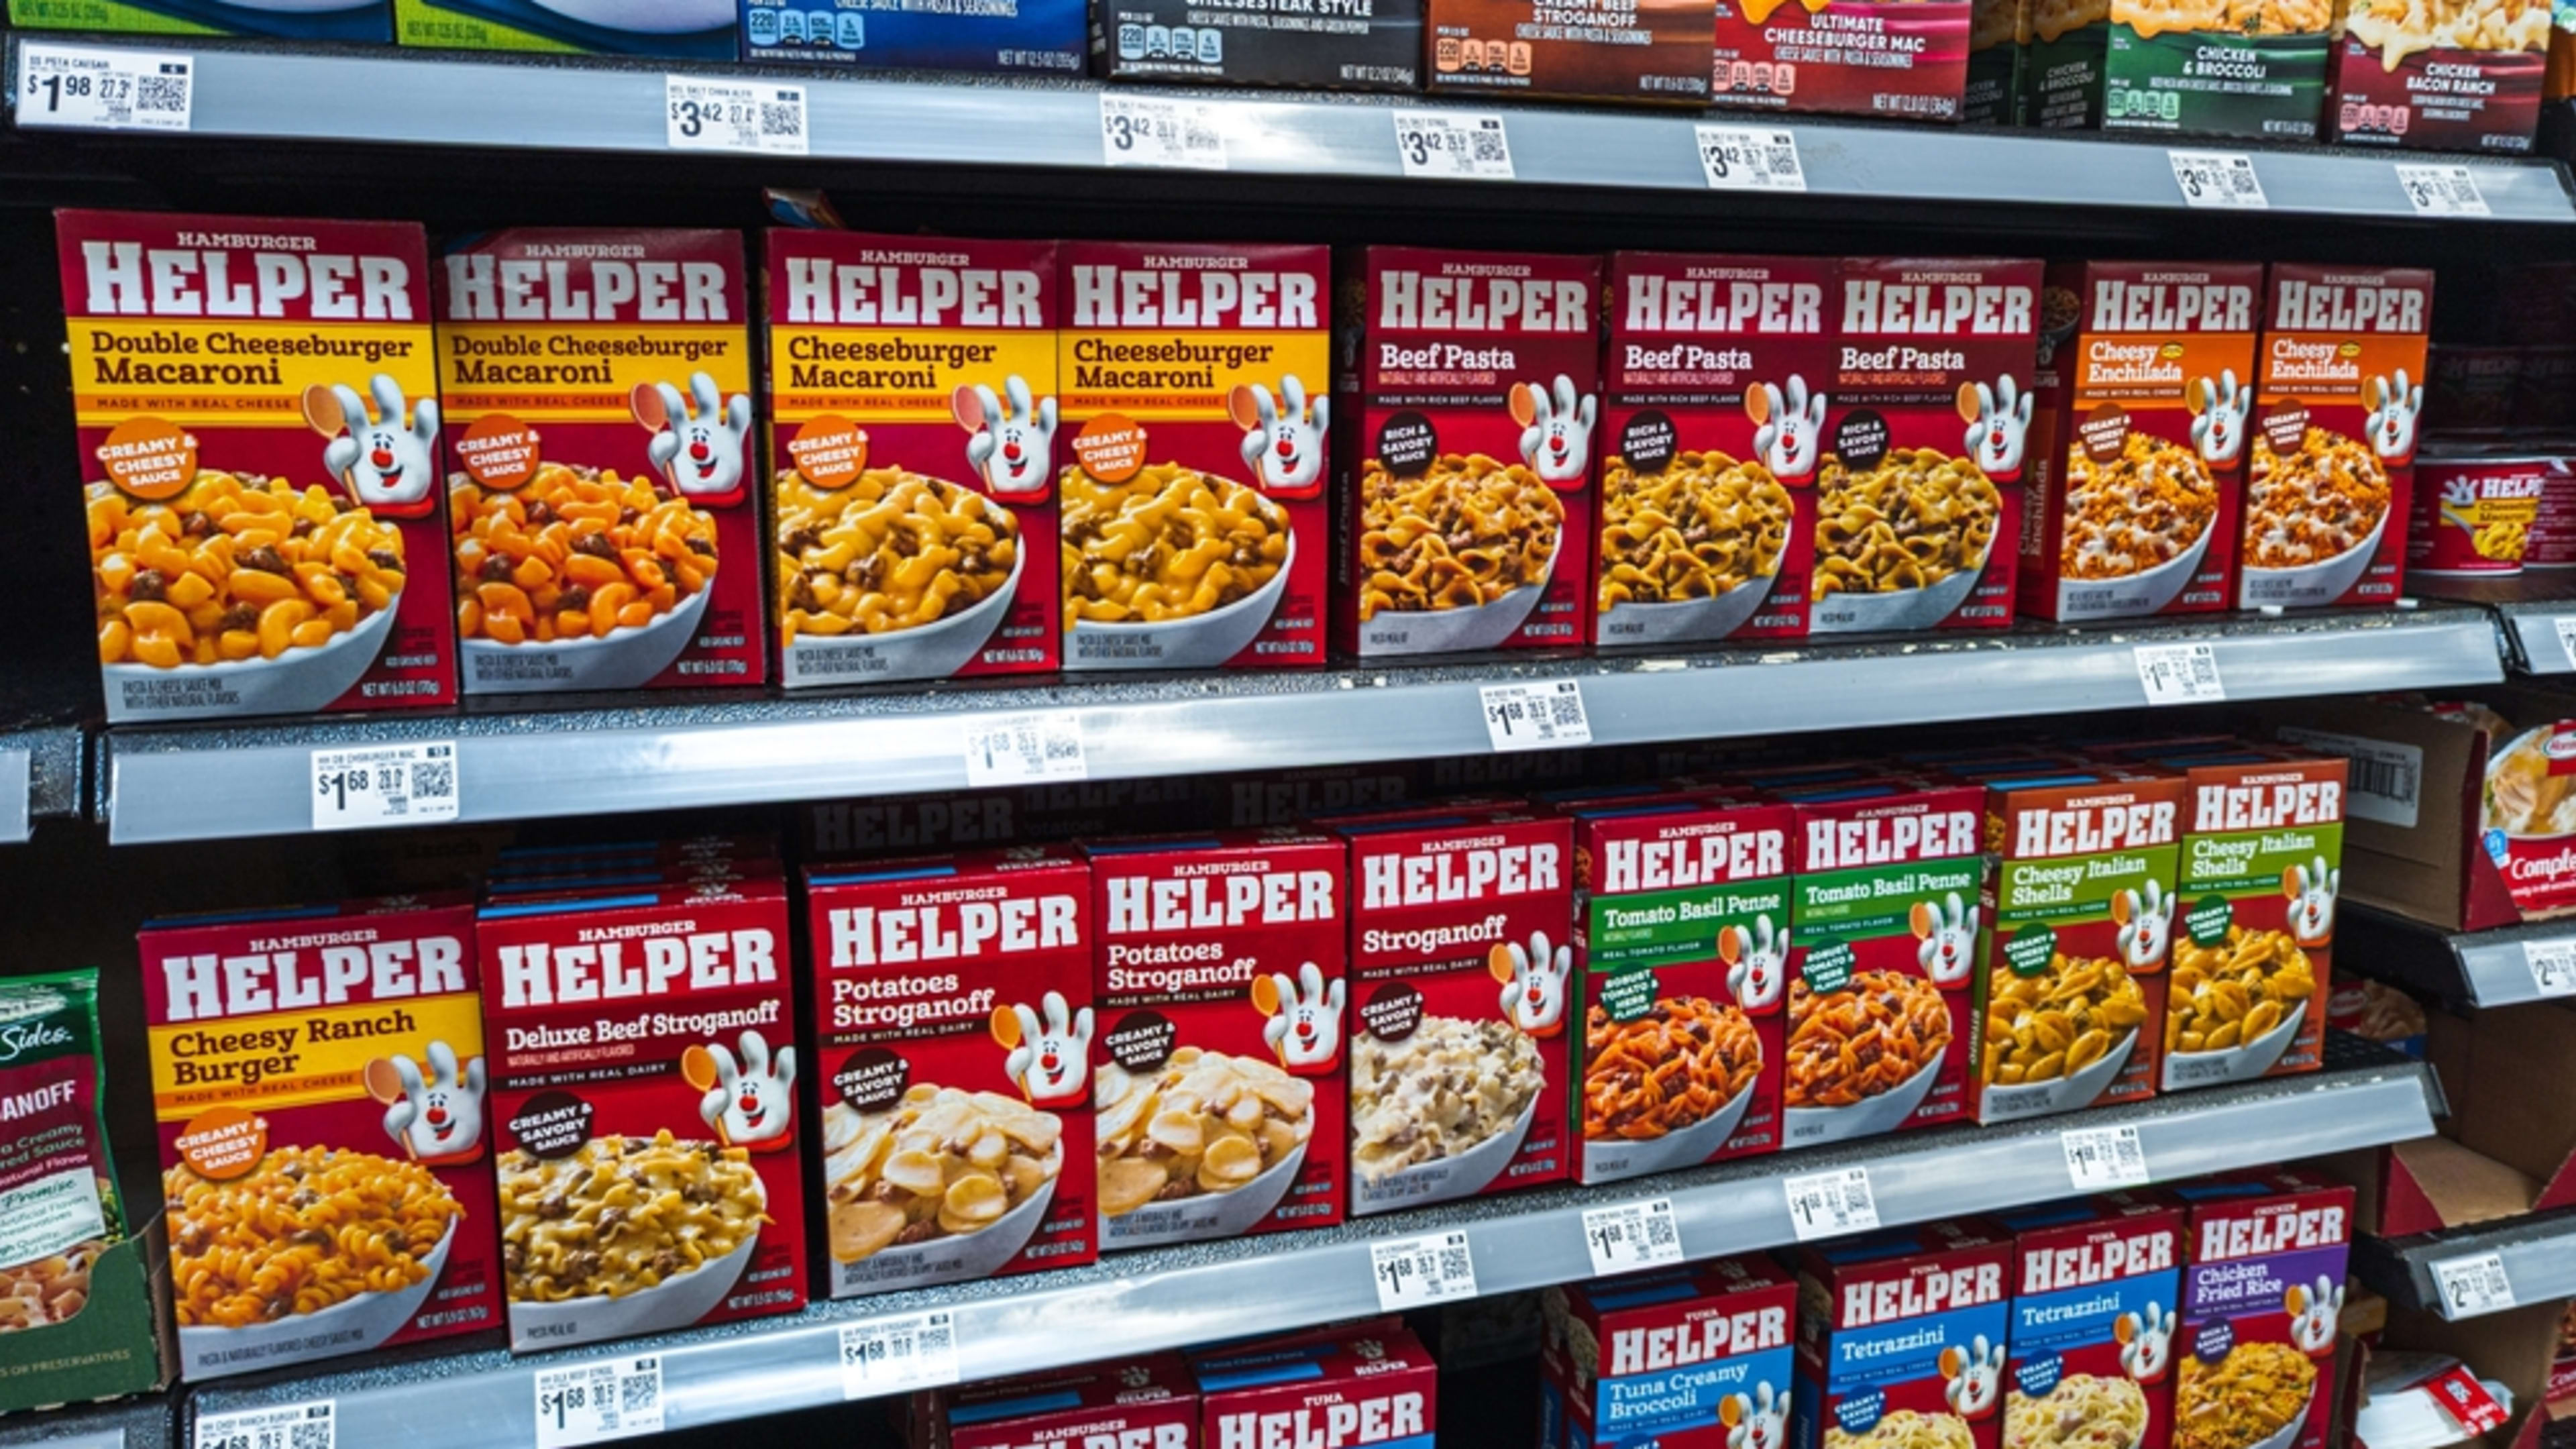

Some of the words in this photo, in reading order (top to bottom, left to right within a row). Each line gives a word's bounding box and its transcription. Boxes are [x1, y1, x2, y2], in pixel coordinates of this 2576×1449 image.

[1318, 1, 1372, 16] STYLE
[1533, 10, 1637, 27] STROGANOFF
[1811, 14, 1884, 32] ULTIMATE
[1764, 28, 1886, 50] CHEESEBURGER
[1890, 35, 1926, 52] MAC
[2196, 46, 2257, 63] CHICKEN
[2183, 62, 2194, 75] &
[2196, 61, 2267, 78] BROCCOLI
[2426, 62, 2481, 78] CHICKEN
[2406, 75, 2452, 93] BACON
[2454, 78, 2496, 96] RANCH
[176, 231, 317, 252] HAMBURGER
[524, 244, 645, 259] HAMBURGER
[860, 250, 970, 266] HAMBURGER
[1143, 256, 1248, 270] HAMBURGER
[1442, 262, 1532, 277] HAMBURGER
[82, 240, 413, 320] HELPER
[1685, 268, 1770, 280] HAMBURGER
[1901, 272, 1983, 284] HAMBURGER
[445, 254, 729, 321] HELPER
[785, 256, 1043, 327] HELPER
[1072, 265, 1318, 328] HELPER
[1379, 270, 1589, 333] HELPER
[1625, 275, 1822, 333] HELPER
[1841, 280, 2033, 334] HELPER
[2092, 280, 2252, 331] HELPER
[2275, 280, 2424, 332] HELPER
[91, 330, 199, 354] Double
[205, 332, 412, 363] Cheeseburger
[451, 335, 543, 357] Double
[547, 335, 728, 361] Cheeseburger
[788, 335, 997, 369] Cheeseburger
[1074, 338, 1273, 370] Cheeseburger
[1379, 342, 1442, 370] Beef
[1444, 344, 1516, 370] Pasta
[1624, 343, 1684, 370] Beef
[1684, 345, 1753, 370] Pasta
[1839, 345, 1898, 370] Beef
[1900, 347, 1966, 370] Pasta
[2088, 341, 2159, 363] Cheesy
[2272, 338, 2338, 362] Cheesy
[94, 356, 283, 385] Macaroni
[454, 358, 613, 384] Macaroni
[790, 364, 937, 390] Macaroni
[1074, 365, 1215, 389] Macaroni
[2088, 362, 2183, 383] Enchilada
[2271, 360, 2359, 380] Enchilada
[97, 398, 140, 409] MADE
[146, 398, 186, 409] WITH
[191, 398, 229, 409] REAL
[236, 398, 291, 410] CHEESE
[95, 437, 176, 460] CREAMY
[182, 434, 199, 448] &
[455, 432, 525, 454] CREAMY
[113, 451, 189, 474] CHEESY
[127, 469, 181, 487] SAUCE
[2195, 780, 2341, 831] HELPER
[1659, 822, 1737, 839] HAMBURGER
[1806, 810, 1976, 871] HELPER
[2015, 801, 2176, 859] HELPER
[1421, 835, 1506, 853] HAMBURGER
[2192, 838, 2259, 859] Cheesy
[2261, 833, 2315, 854] Italian
[1173, 860, 1271, 877] HAMBURGER
[1605, 829, 1784, 893] HELPER
[2012, 864, 2084, 885] Cheesy
[2087, 856, 2146, 879] Italian
[2192, 857, 2248, 877] Shells
[1362, 843, 1560, 910] HELPER
[1805, 882, 1871, 905] Tomato
[1873, 875, 1916, 897] Basil
[1918, 872, 1971, 892] Penne
[900, 886, 1008, 906] HAMBURGER
[1106, 869, 1335, 934] HELPER
[2012, 883, 2073, 906] Shells
[1604, 906, 1676, 929] Tomato
[1678, 897, 1725, 921] Basil
[1726, 894, 1780, 915] Penne
[250, 928, 379, 953] HAMBURGER
[578, 920, 697, 943] HAMBURGER
[828, 894, 1079, 968] HELPER
[1362, 914, 1507, 954] Stroganoff
[498, 927, 777, 1008] HELPER
[1107, 942, 1224, 967] Potatoes
[162, 935, 466, 1022] HELPER
[1107, 957, 1257, 992] Stroganoff
[831, 974, 959, 1002] Potatoes
[833, 987, 996, 1028] Stroganoff
[170, 1026, 299, 1059] Cheesy
[307, 1008, 417, 1043] Ranch
[506, 1022, 592, 1051] Deluxe
[596, 1014, 651, 1040] Beef
[653, 999, 782, 1037] Stroganoff
[0, 1021, 68, 1061] Sides
[172, 1053, 300, 1086] Burger
[508, 1077, 545, 1088] MADE
[551, 1073, 586, 1084] WITH
[590, 1068, 623, 1080] REAL
[627, 1063, 667, 1076] DAIRY
[0, 1079, 76, 1122] ANOFF
[508, 1106, 578, 1131] CREAMY
[580, 1102, 593, 1115] &
[17, 1124, 83, 1148] Creamy
[520, 1118, 587, 1143] SAVORY
[535, 1132, 581, 1152] SAUCE
[33, 1136, 85, 1158] Sauce
[46, 1153, 90, 1169] Flavor
[2200, 1206, 2345, 1262] HELPER
[2023, 1230, 2174, 1294] HELPER
[2198, 1263, 2269, 1286] Chicken
[1841, 1263, 2001, 1329] HELPER
[2195, 1282, 2242, 1304] Fried
[2247, 1278, 2282, 1295] Rice
[1685, 1308, 1719, 1323] TUNA
[2022, 1291, 2121, 1326] Tetrazzini
[1611, 1305, 1787, 1376] HELPER
[1841, 1324, 1945, 1361] Tetrazzini
[1609, 1379, 1666, 1401] Tuna
[1669, 1363, 1749, 1391] Creamy
[1303, 1392, 1344, 1407] TUNA
[1609, 1389, 1697, 1420] Broccoli
[1032, 1419, 1128, 1442] HAMBURGER
[1218, 1391, 1424, 1449] HELPER
